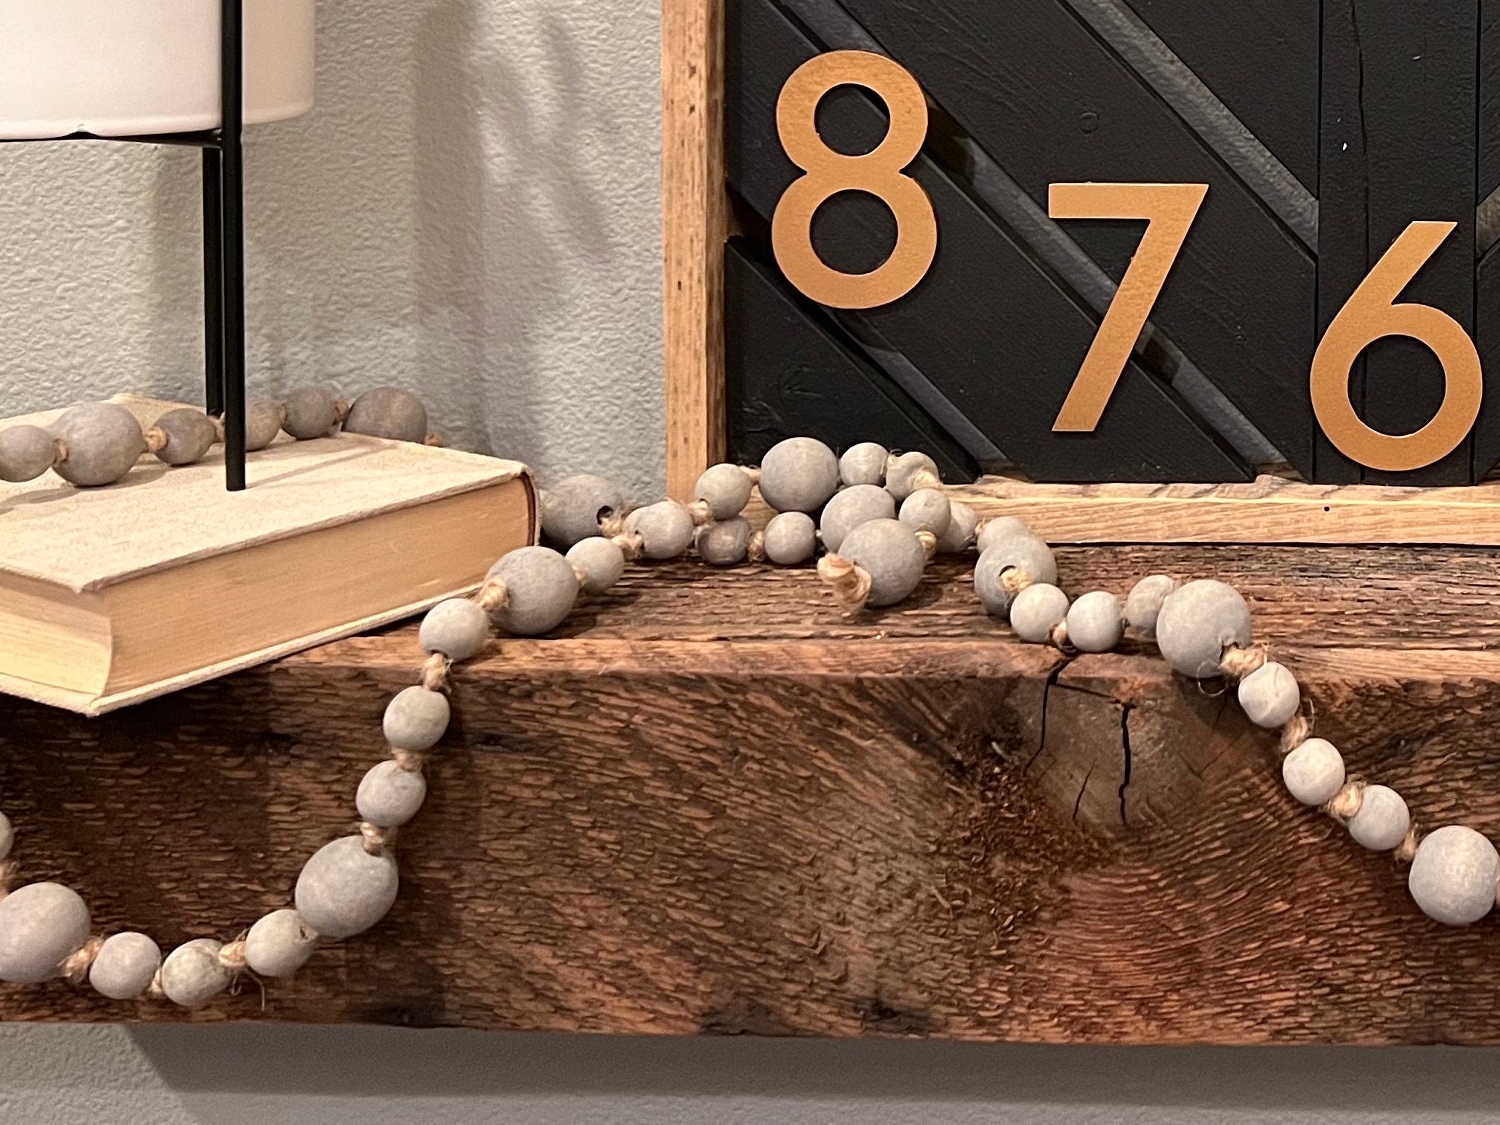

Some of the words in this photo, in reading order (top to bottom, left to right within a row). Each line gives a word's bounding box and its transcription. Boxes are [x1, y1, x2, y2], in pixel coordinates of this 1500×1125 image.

[771, 49, 938, 310] 8
[1047, 181, 1209, 432] 7
[1310, 220, 1484, 472] 6
